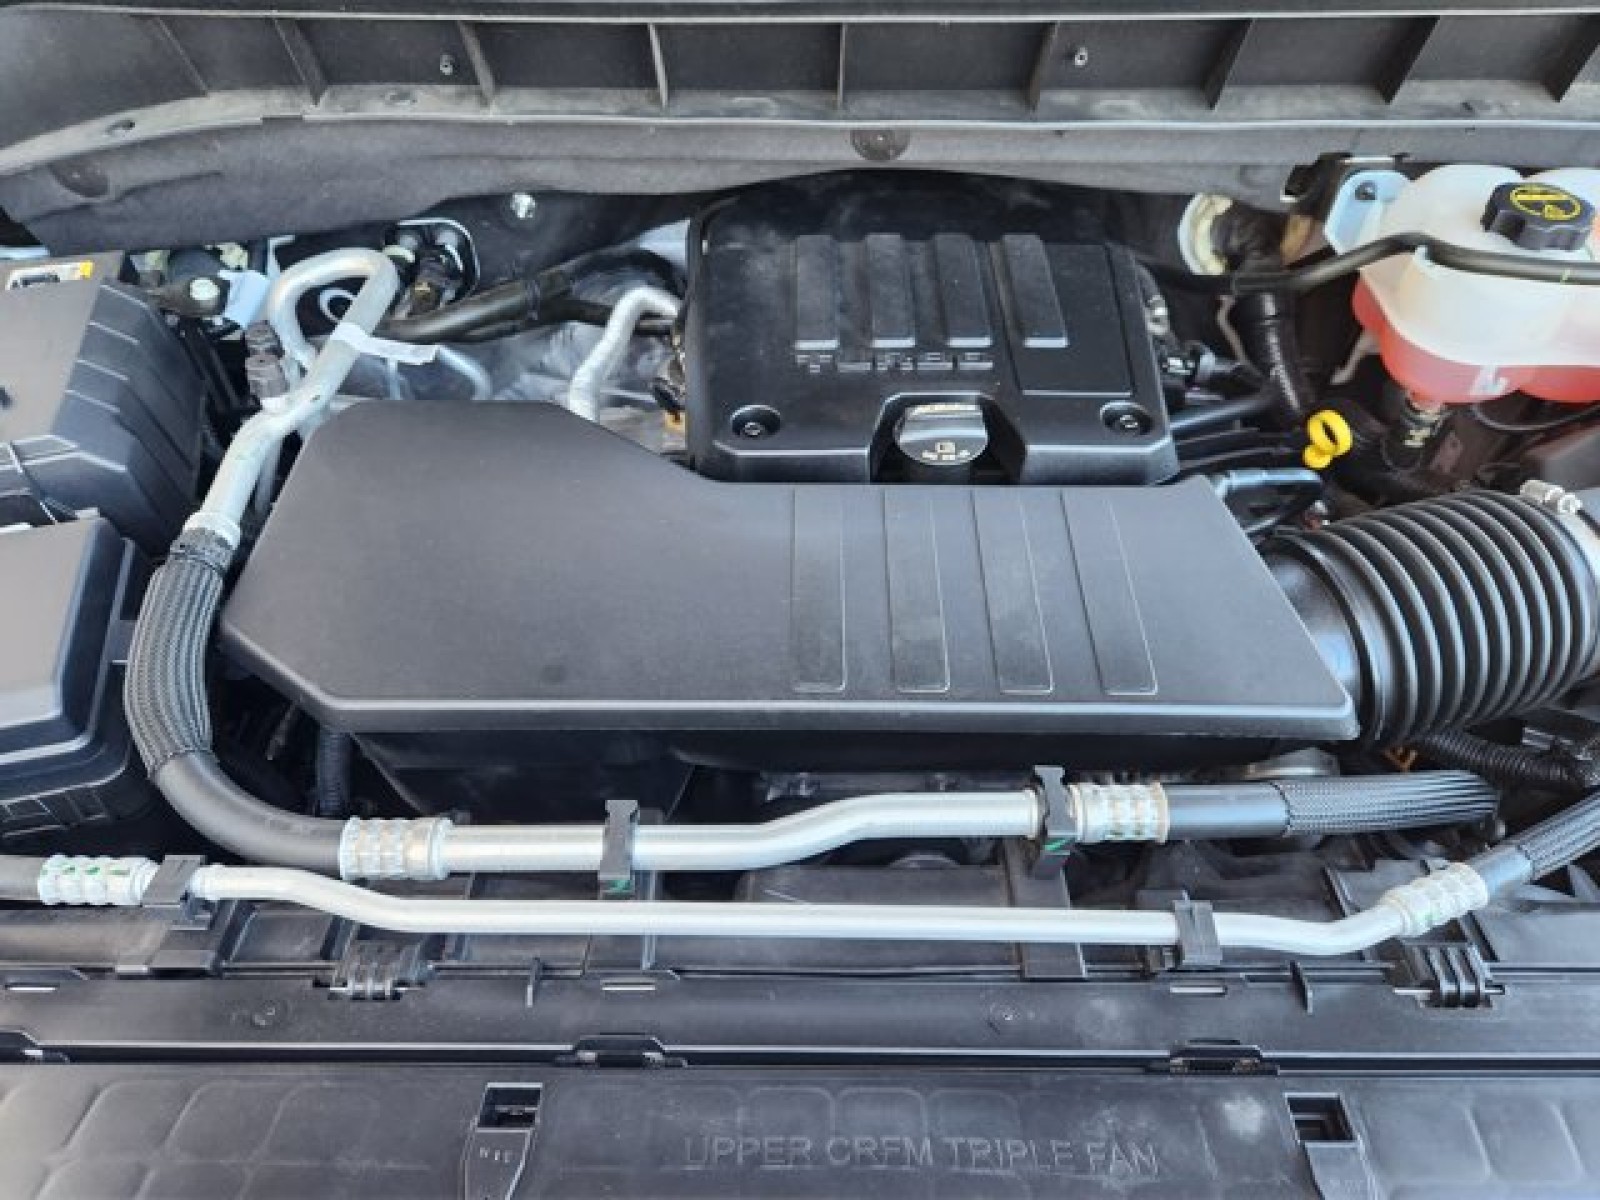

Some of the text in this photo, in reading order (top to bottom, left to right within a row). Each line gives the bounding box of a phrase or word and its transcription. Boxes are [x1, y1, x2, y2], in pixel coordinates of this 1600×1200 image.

[684, 1135, 1159, 1175] UPPER CRFM TRIPLE FAN
